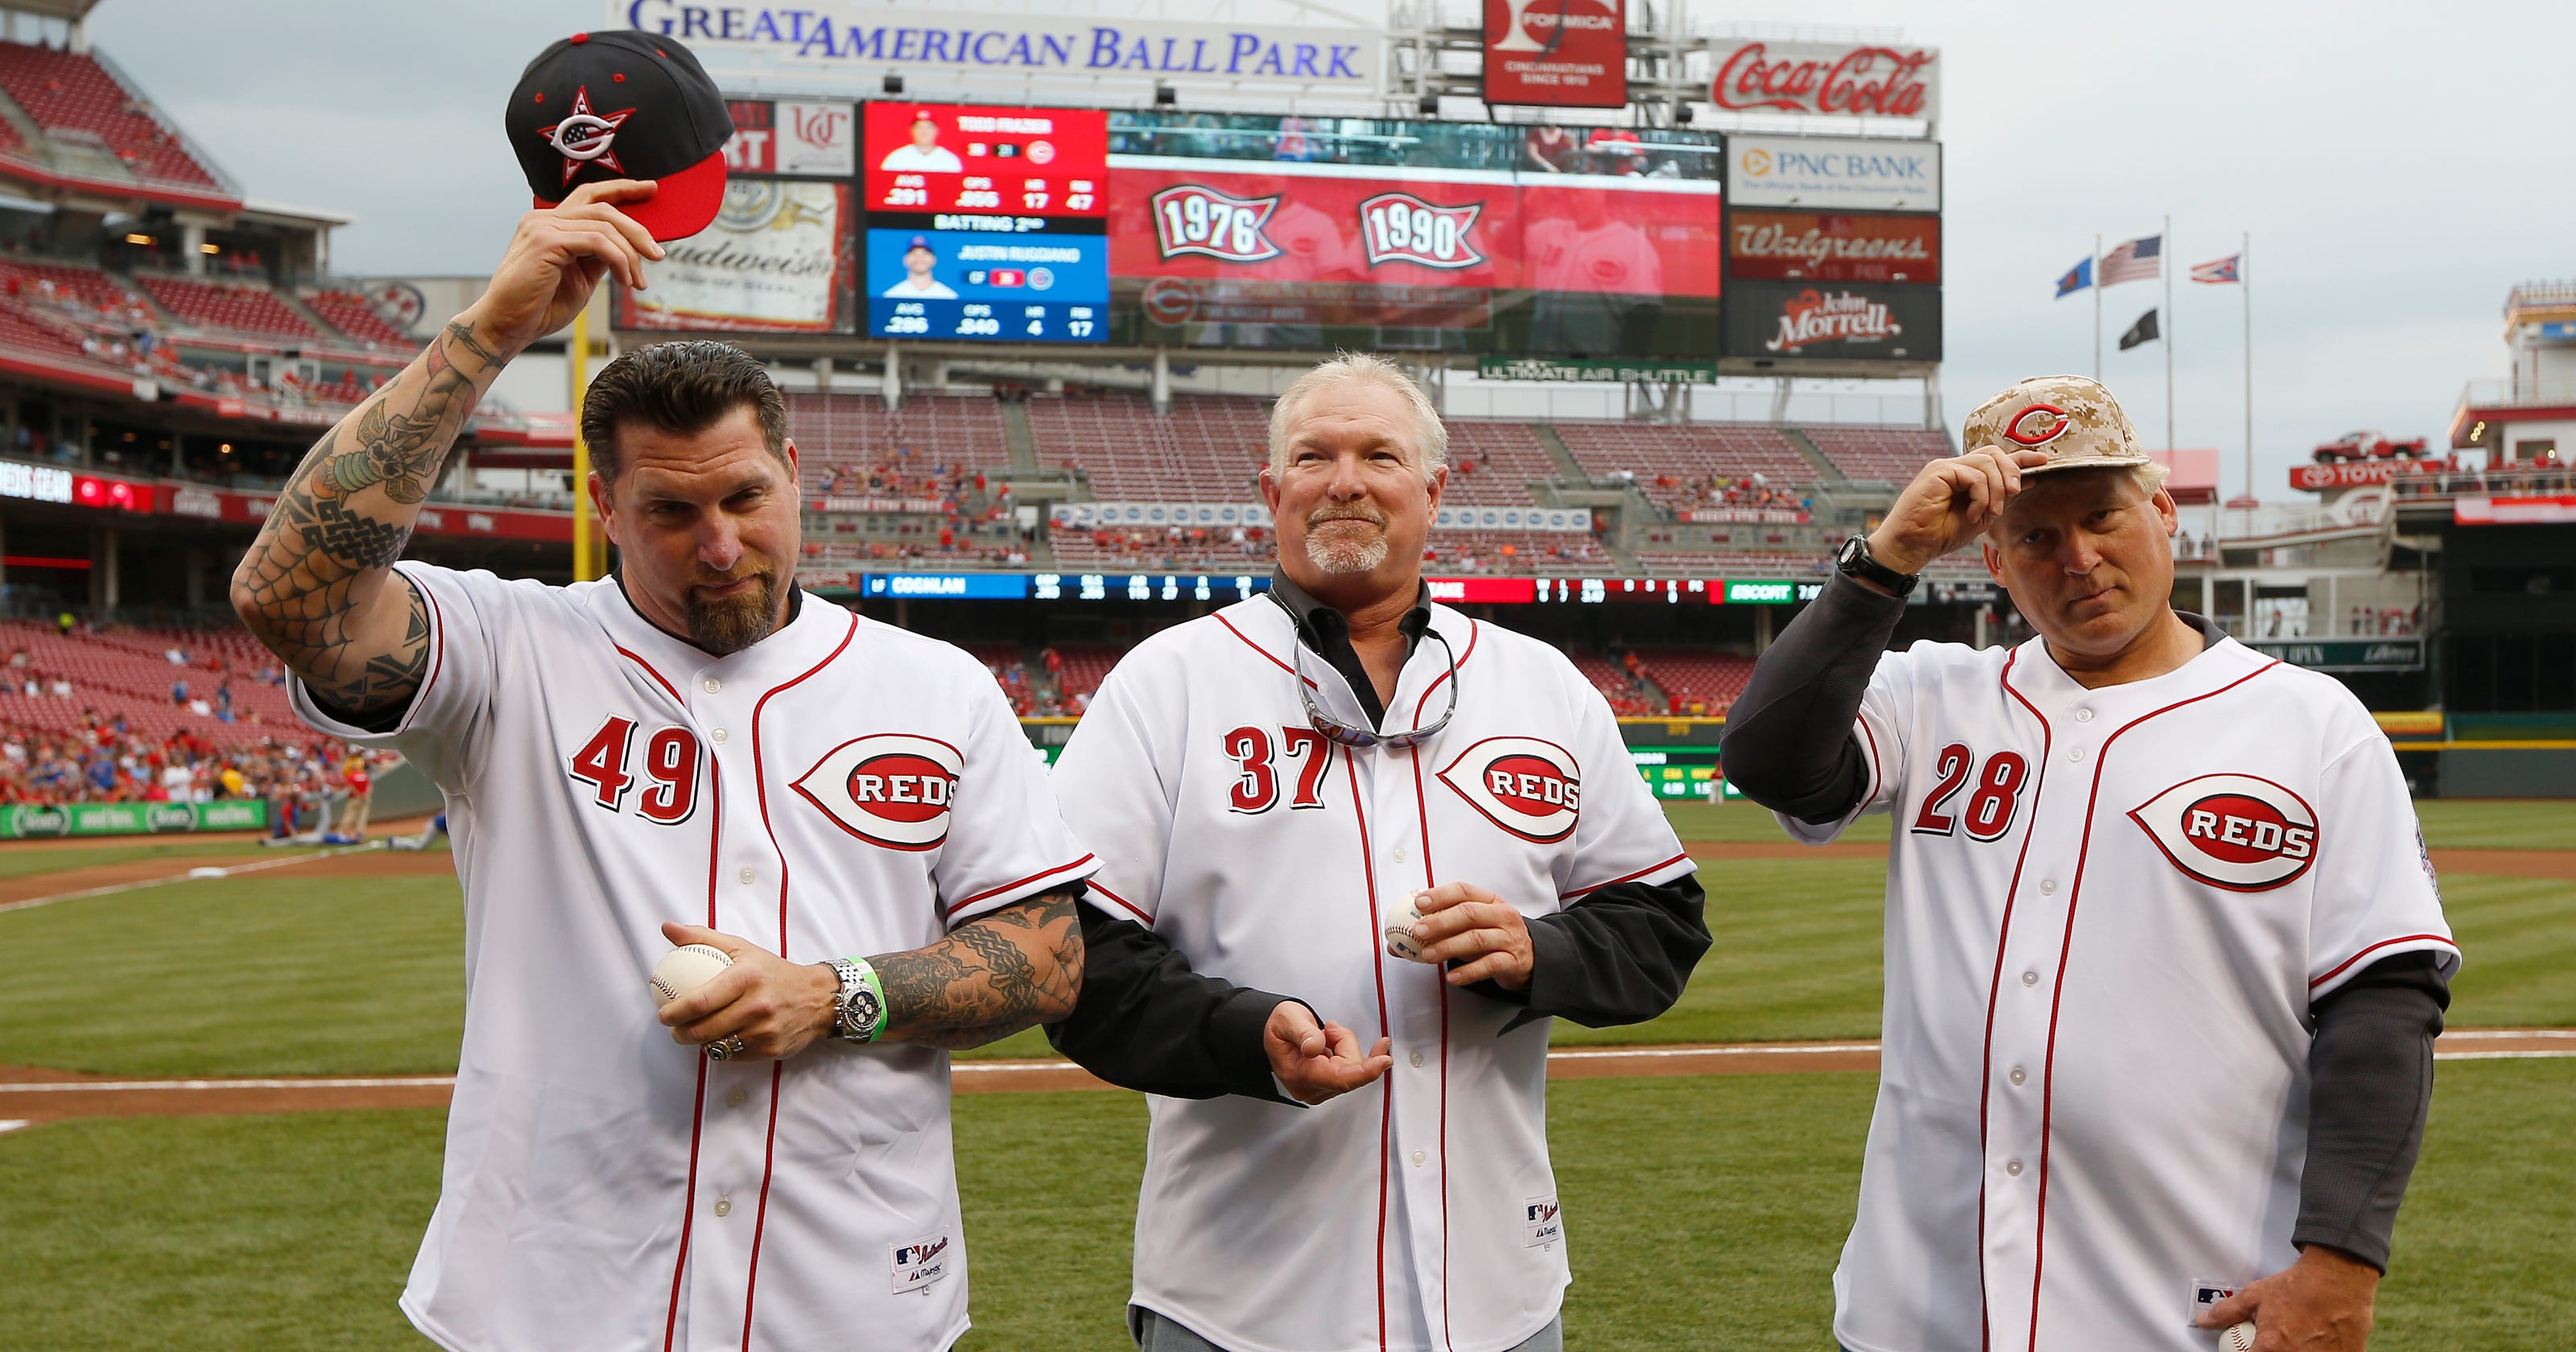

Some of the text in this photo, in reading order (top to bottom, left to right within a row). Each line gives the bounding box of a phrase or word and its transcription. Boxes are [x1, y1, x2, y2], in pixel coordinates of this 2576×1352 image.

[1086, 27, 1218, 73] BALL
[1226, 32, 1365, 79] PARK
[1520, 72, 1560, 85] SINCE
[1711, 42, 1936, 116] Coca-Cola
[957, 116, 995, 132] TODD
[724, 130, 769, 167] RT
[1777, 151, 1926, 179] PNC BANK
[1023, 192, 1049, 209] 17
[1066, 193, 1094, 210] 47
[934, 213, 1013, 232] BATTING
[1164, 194, 1257, 256] 1976
[1370, 202, 1457, 261] 1990
[665, 241, 835, 275] udweiser
[1736, 222, 1929, 266] Walgreens
[1815, 291, 1867, 315] John
[1067, 320, 1094, 337] 17
[1765, 303, 1901, 351] Morrell
[1481, 363, 1708, 382] ULTIMATE AIR SHUTTLE
[2338, 462, 2424, 483] TOYOA
[1536, 579, 1551, 590] W
[567, 711, 703, 826] 49
[1219, 721, 1335, 815] 37
[1488, 769, 1580, 811] REDS
[1910, 740, 2031, 843] 28
[2188, 808, 2315, 859] REDS
